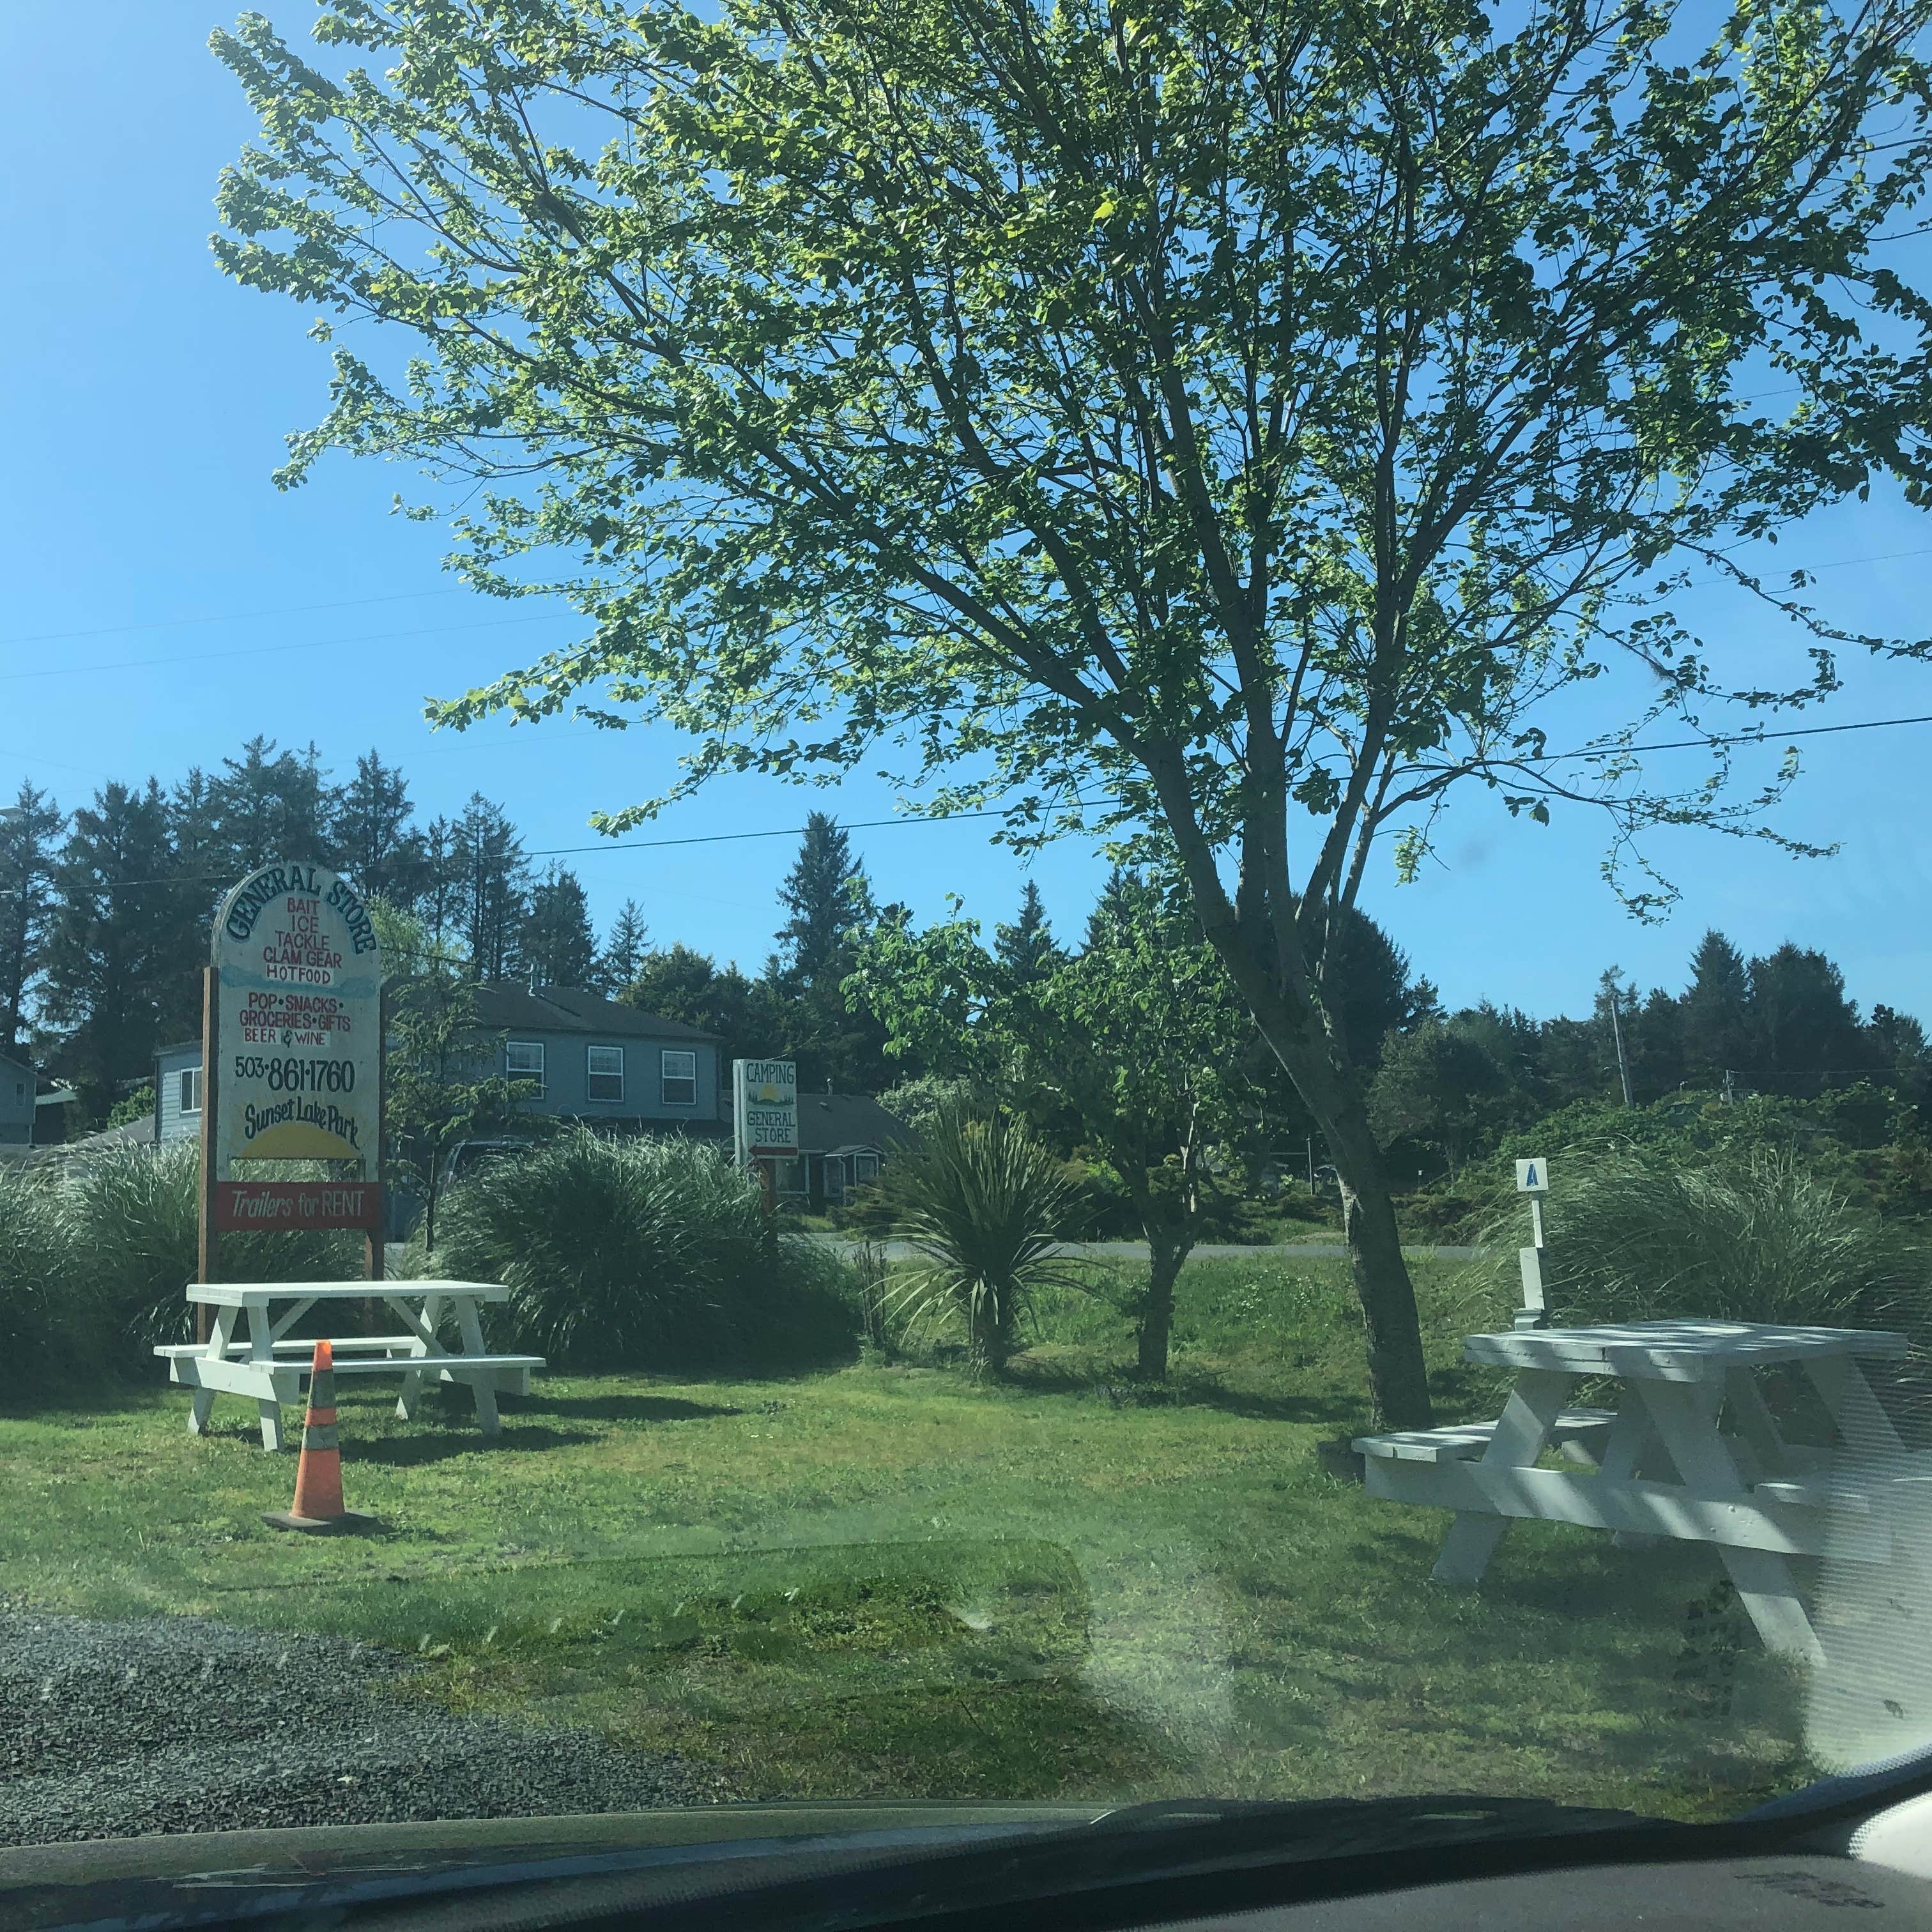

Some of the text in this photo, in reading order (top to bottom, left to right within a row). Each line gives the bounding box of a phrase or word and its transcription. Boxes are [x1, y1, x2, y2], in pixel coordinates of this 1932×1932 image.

[226, 866, 377, 955] GENERAL STORE
[287, 897, 319, 915] BAIT
[291, 916, 319, 933] ICE
[275, 930, 330, 951] TACKLE
[263, 946, 343, 969] CLAM GEAR
[244, 1029, 277, 1044] BEER
[295, 1032, 326, 1046] WINE
[746, 1062, 795, 1084] CAMPING
[245, 1096, 360, 1150] Sunset Lake Park
[747, 1110, 796, 1127] GENERAL
[755, 1128, 792, 1144] STORE
[232, 1190, 365, 1218] Trailers for RENT
